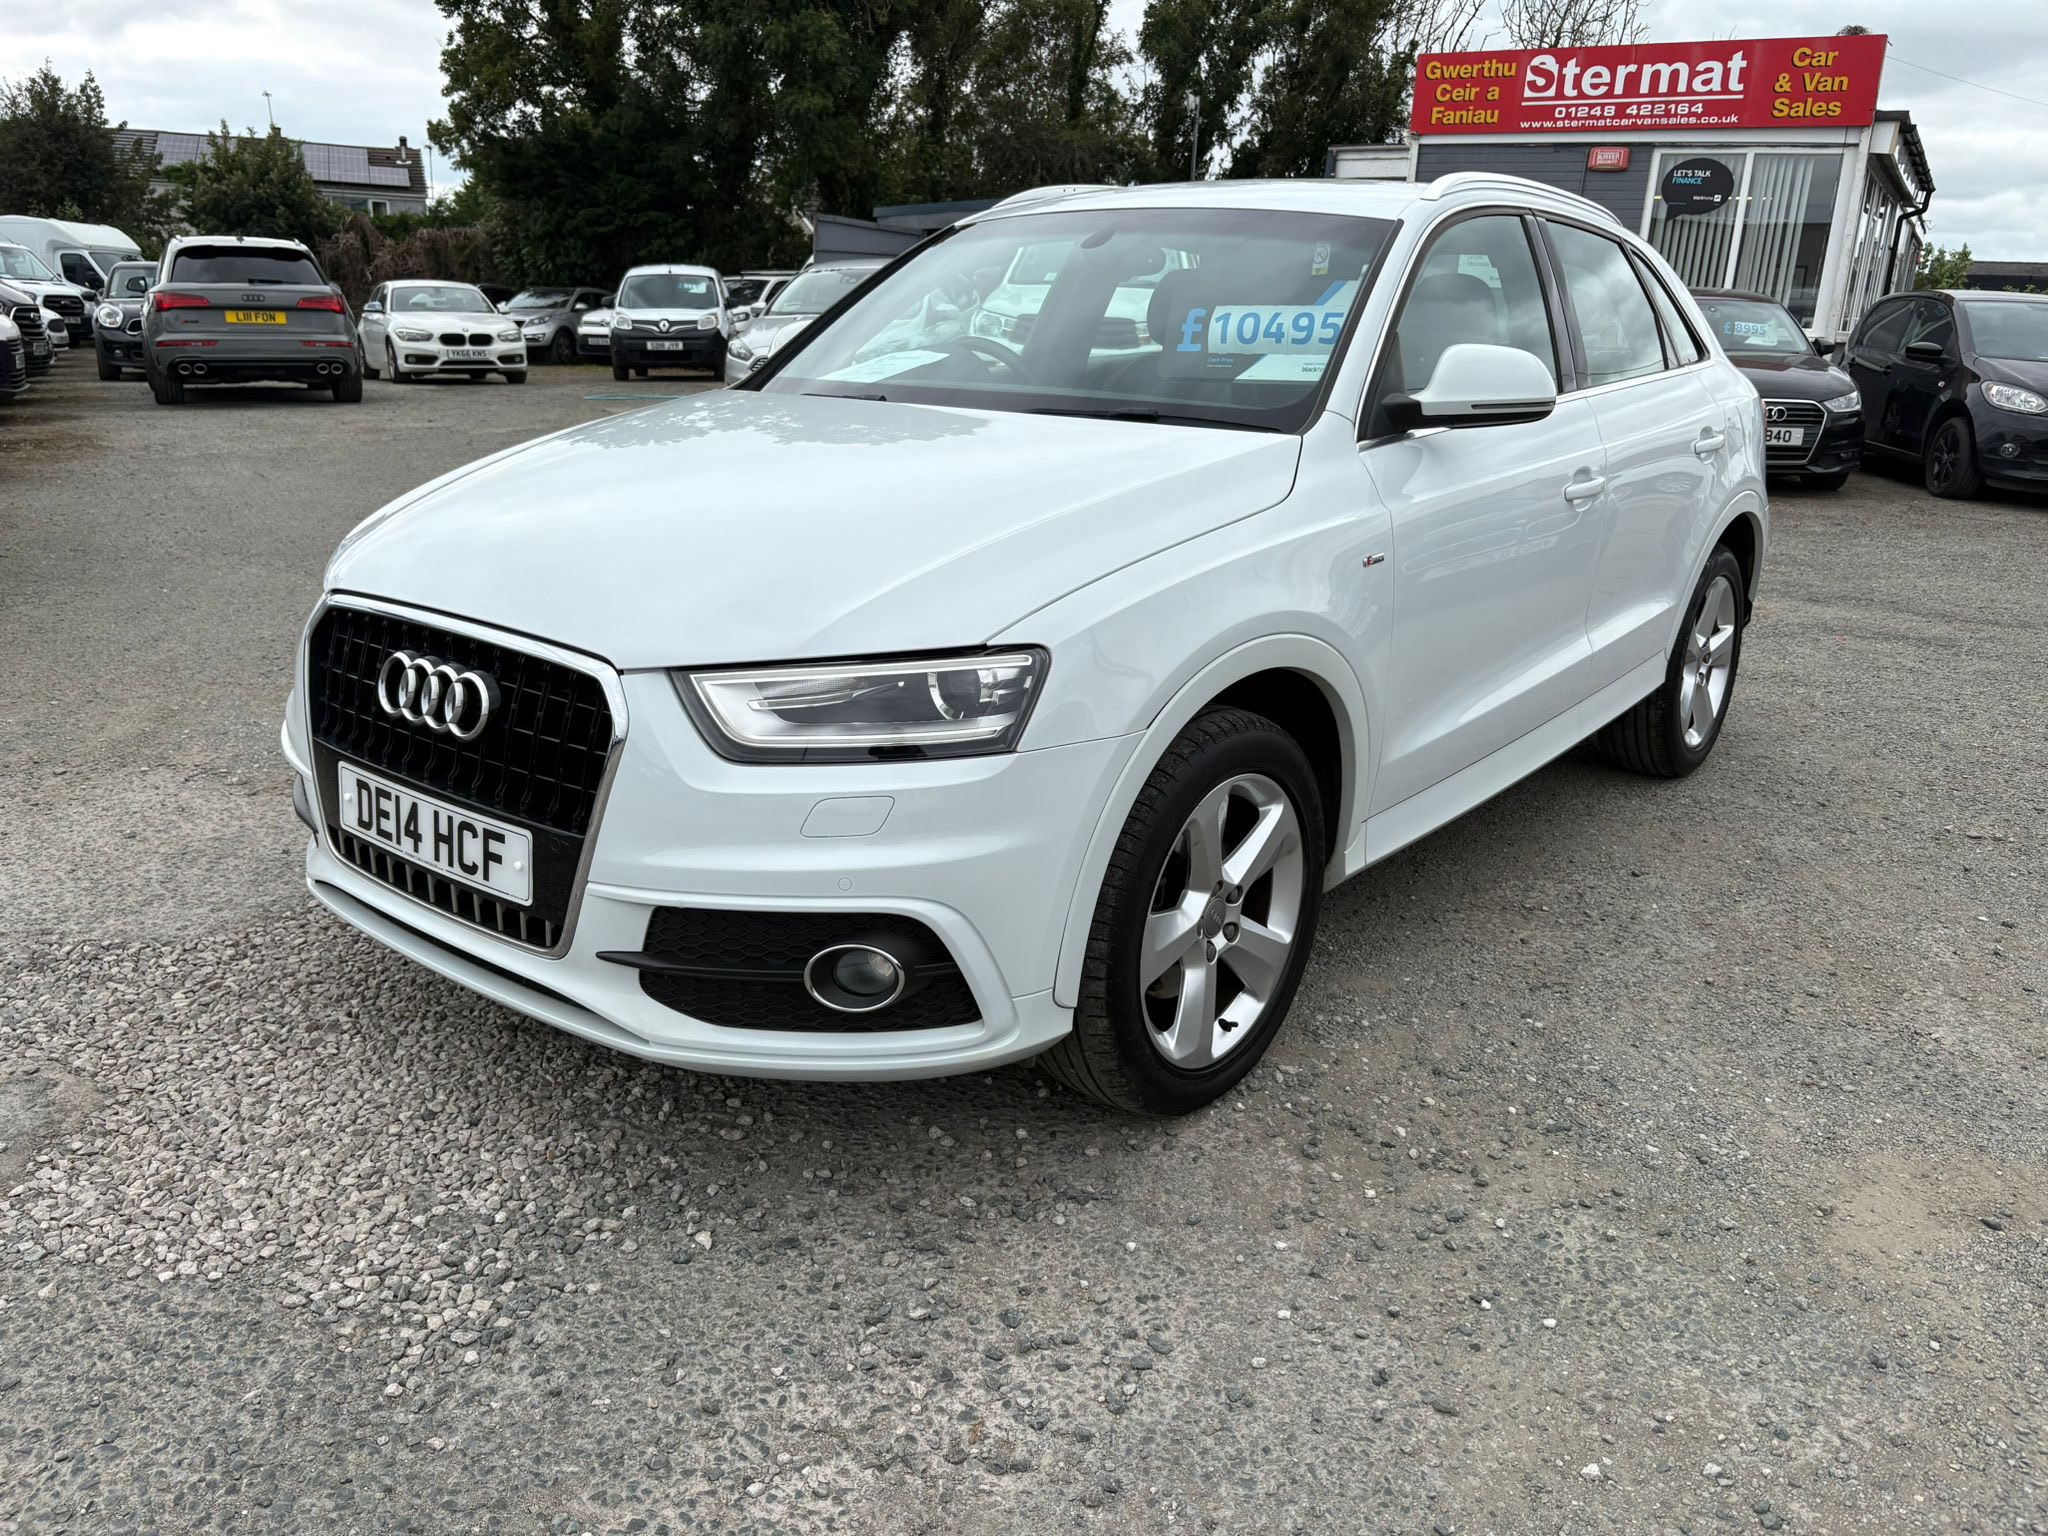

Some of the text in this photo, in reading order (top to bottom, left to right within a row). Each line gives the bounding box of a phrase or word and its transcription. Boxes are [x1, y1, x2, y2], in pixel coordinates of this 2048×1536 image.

[1792, 47, 1838, 67] Car
[1425, 59, 1517, 80] Gwerthu
[1524, 51, 1747, 97] Stermat
[1774, 72, 1849, 93] & Van
[1435, 83, 1500, 102] Ceir a
[1430, 106, 1499, 125] Faniau
[1554, 102, 1704, 118] 01248 422164
[1771, 97, 1842, 118] Sales
[1519, 113, 1739, 129] www.stermatcarvansales.co.uk
[1671, 177, 1703, 185] FINANCE
[1673, 169, 1711, 177] LET'S TALK
[254, 312, 277, 322] FON
[451, 350, 487, 358] YK66 KNS
[356, 778, 506, 883] DE14 HCF
